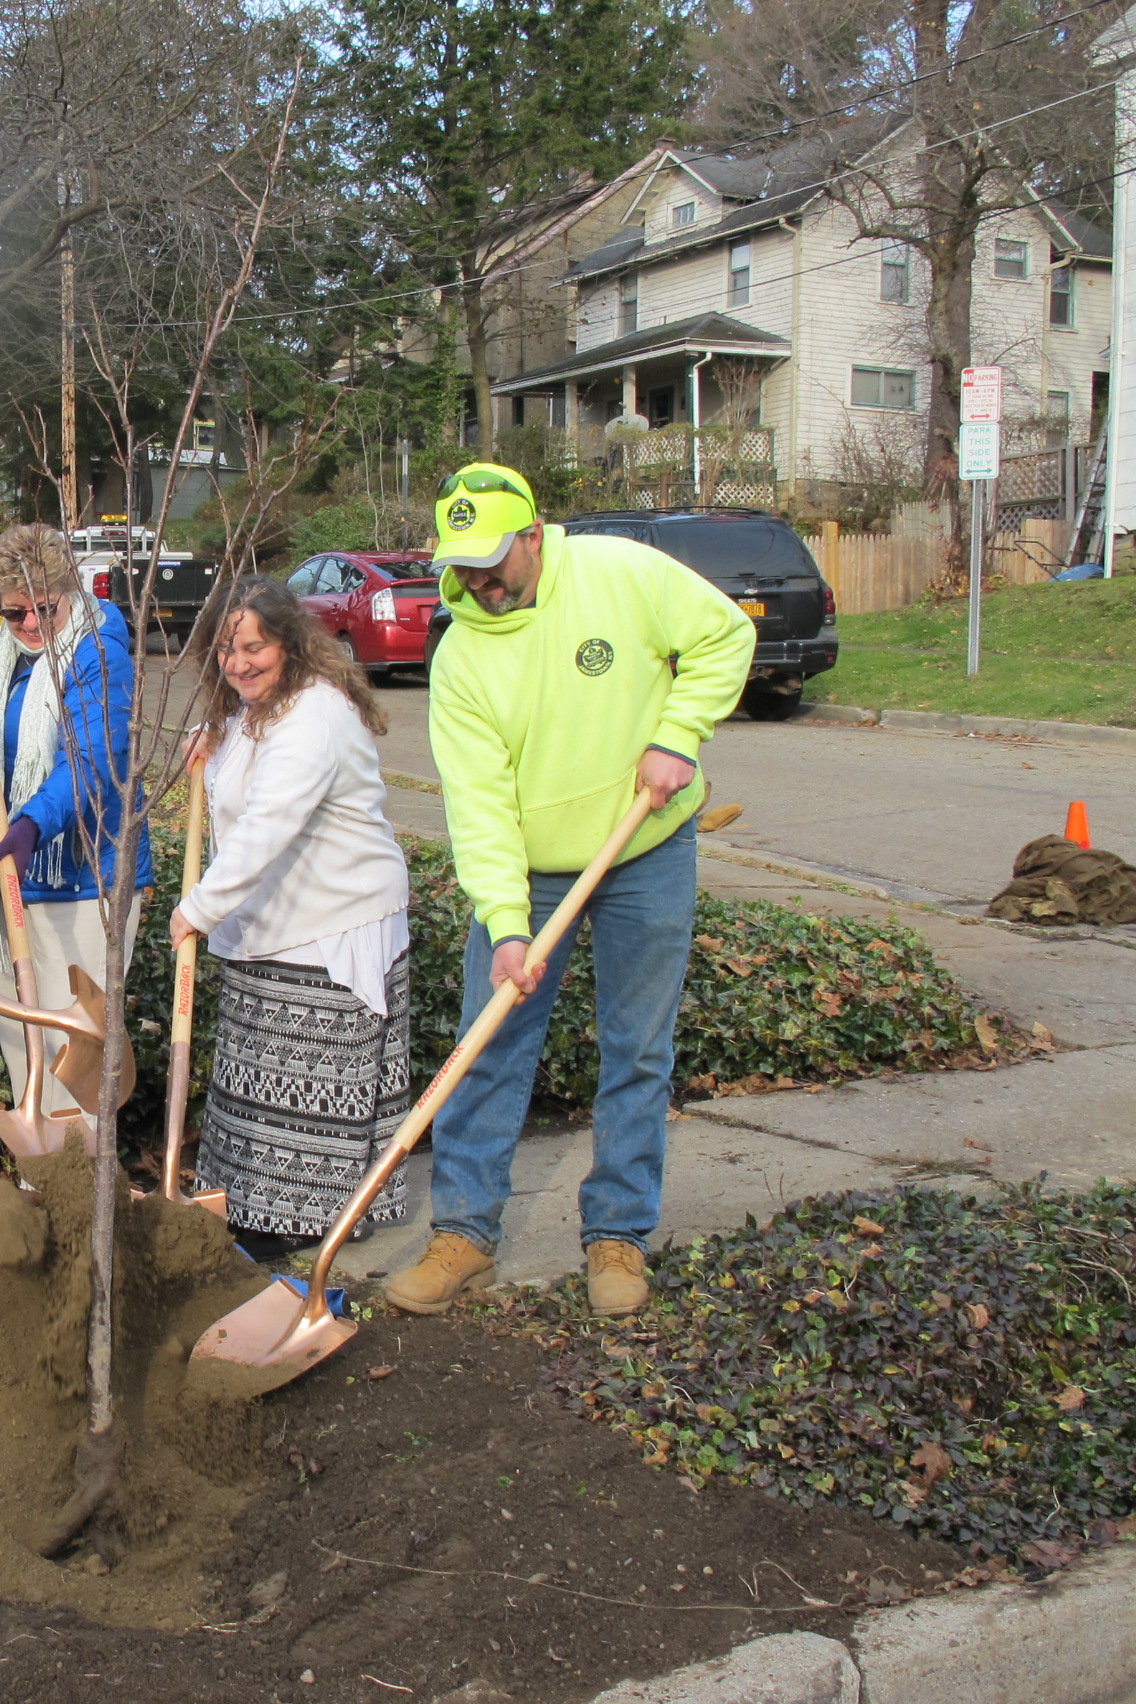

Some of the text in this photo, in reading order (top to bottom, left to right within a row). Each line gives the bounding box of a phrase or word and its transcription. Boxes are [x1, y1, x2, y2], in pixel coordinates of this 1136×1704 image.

[963, 373, 998, 383] NO PARKING
[967, 427, 992, 435] PARK
[969, 438, 991, 446] THIS
[969, 449, 991, 457] SIDE
[966, 459, 992, 467] ONLY
[6, 874, 24, 929] RAZORBACK
[178, 963, 191, 1016] RAZORBACK
